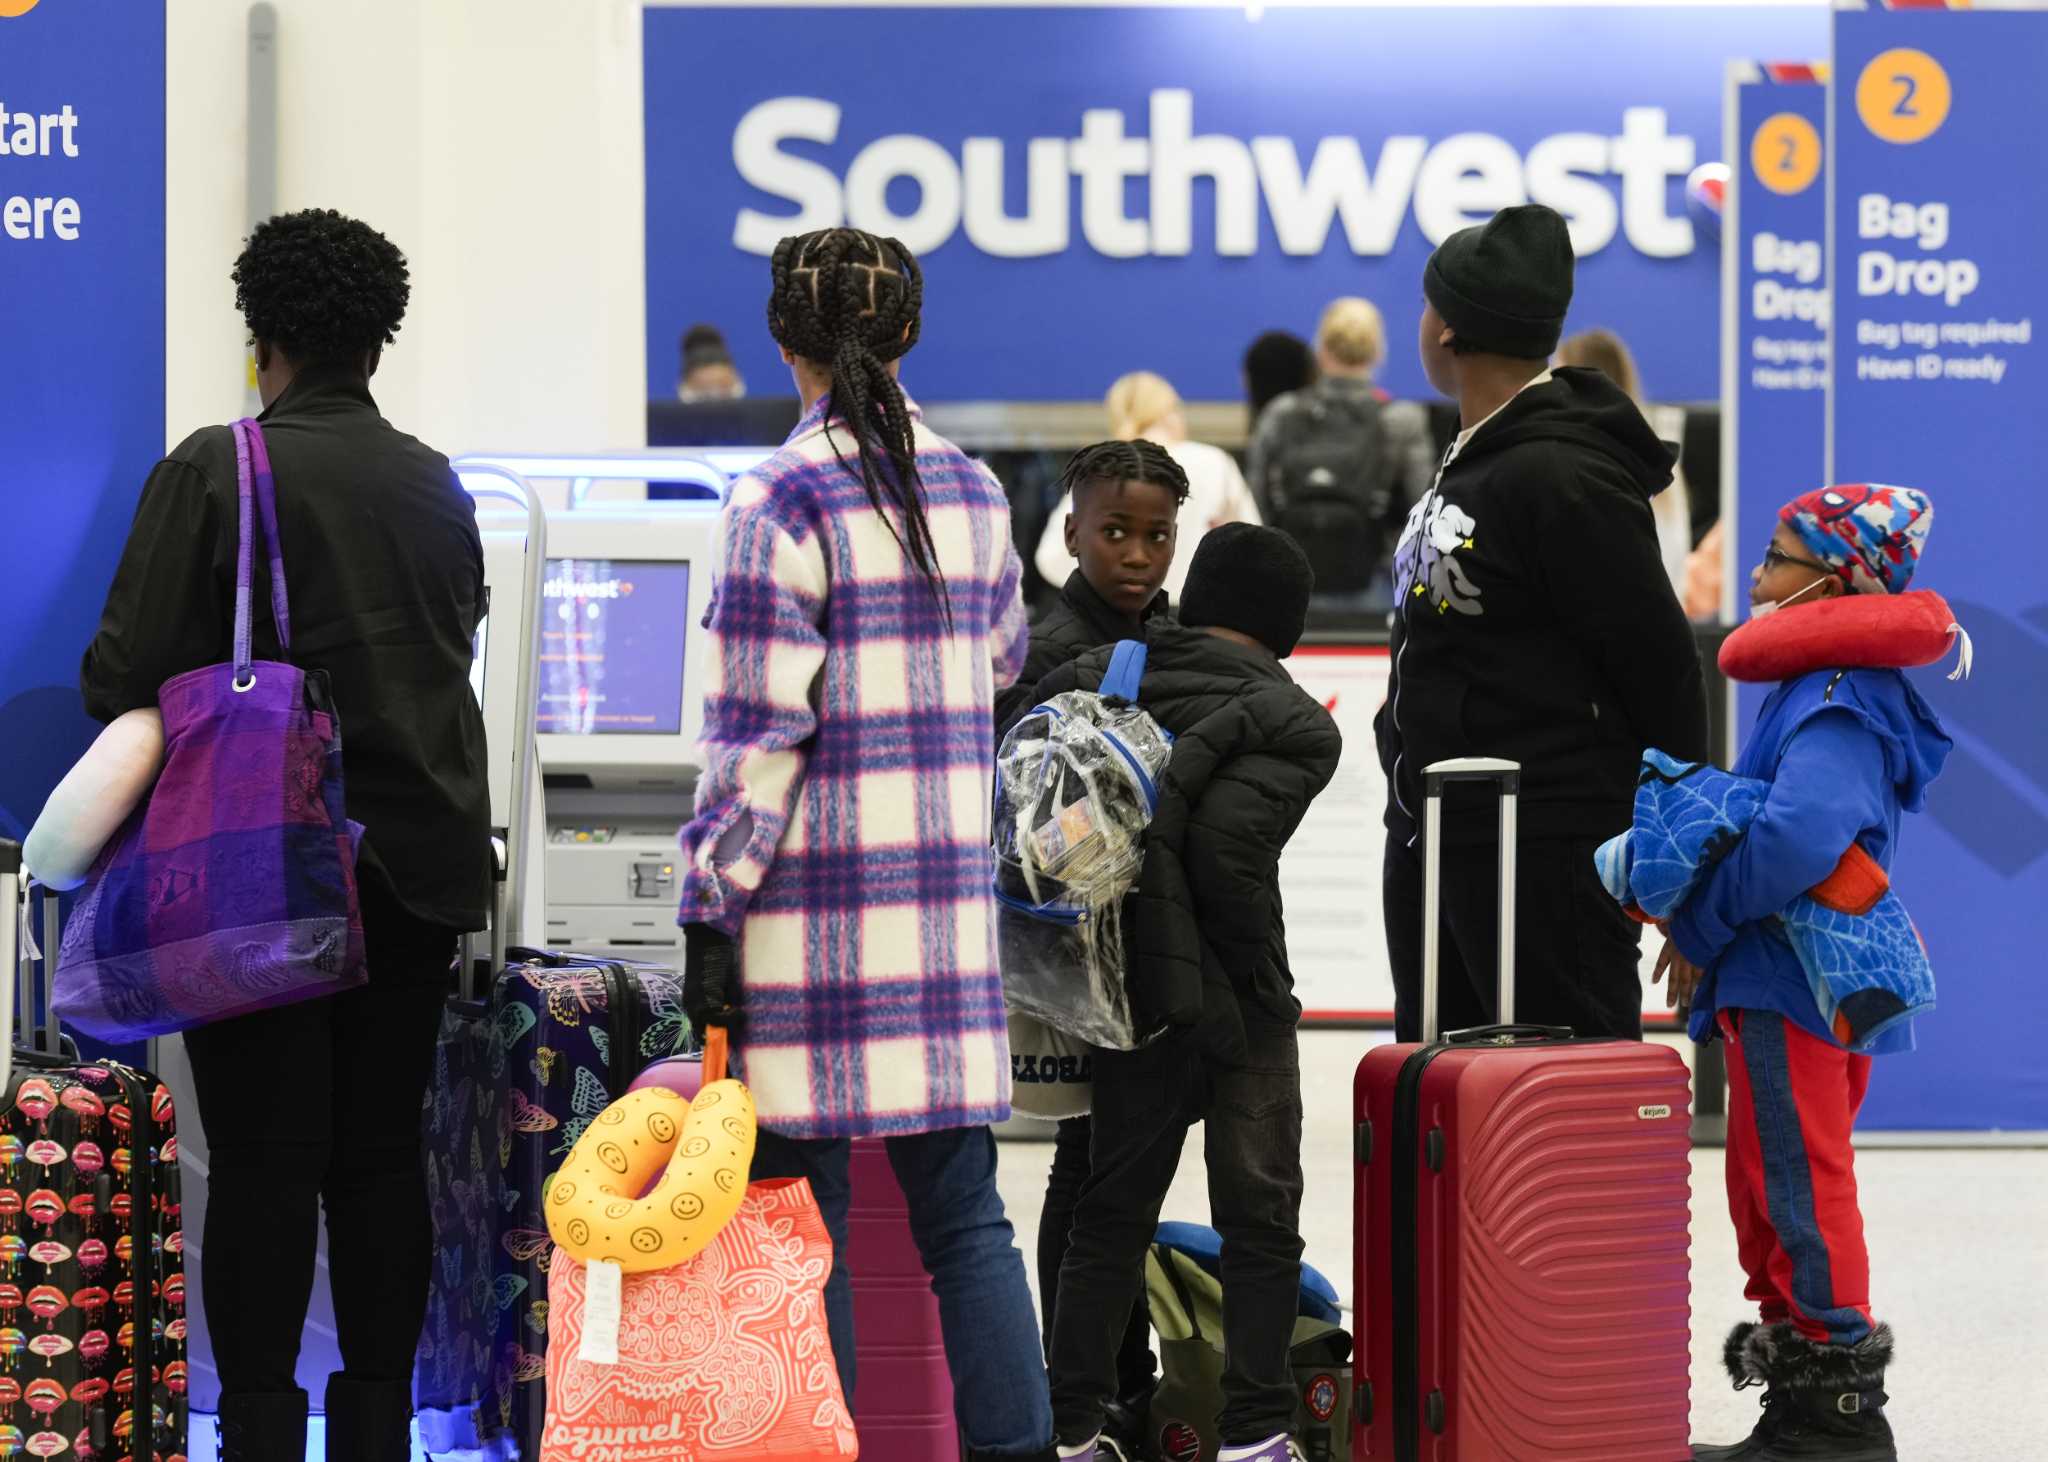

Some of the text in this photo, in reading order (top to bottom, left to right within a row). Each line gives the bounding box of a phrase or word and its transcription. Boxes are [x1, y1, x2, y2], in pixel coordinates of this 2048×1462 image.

[1888, 75, 1919, 117] 2
[732, 88, 1696, 259] Southwest
[1776, 138, 1798, 172] 2
[1857, 194, 1950, 250] Bag
[1752, 232, 1822, 283] Bag
[1857, 251, 1980, 307] Drop
[1856, 319, 1900, 350] Bag
[1901, 320, 1938, 350] tag
[1940, 317, 2032, 348] required
[1856, 355, 1914, 380] Have
[1915, 353, 1943, 380] ID
[1943, 353, 2007, 384] ready
